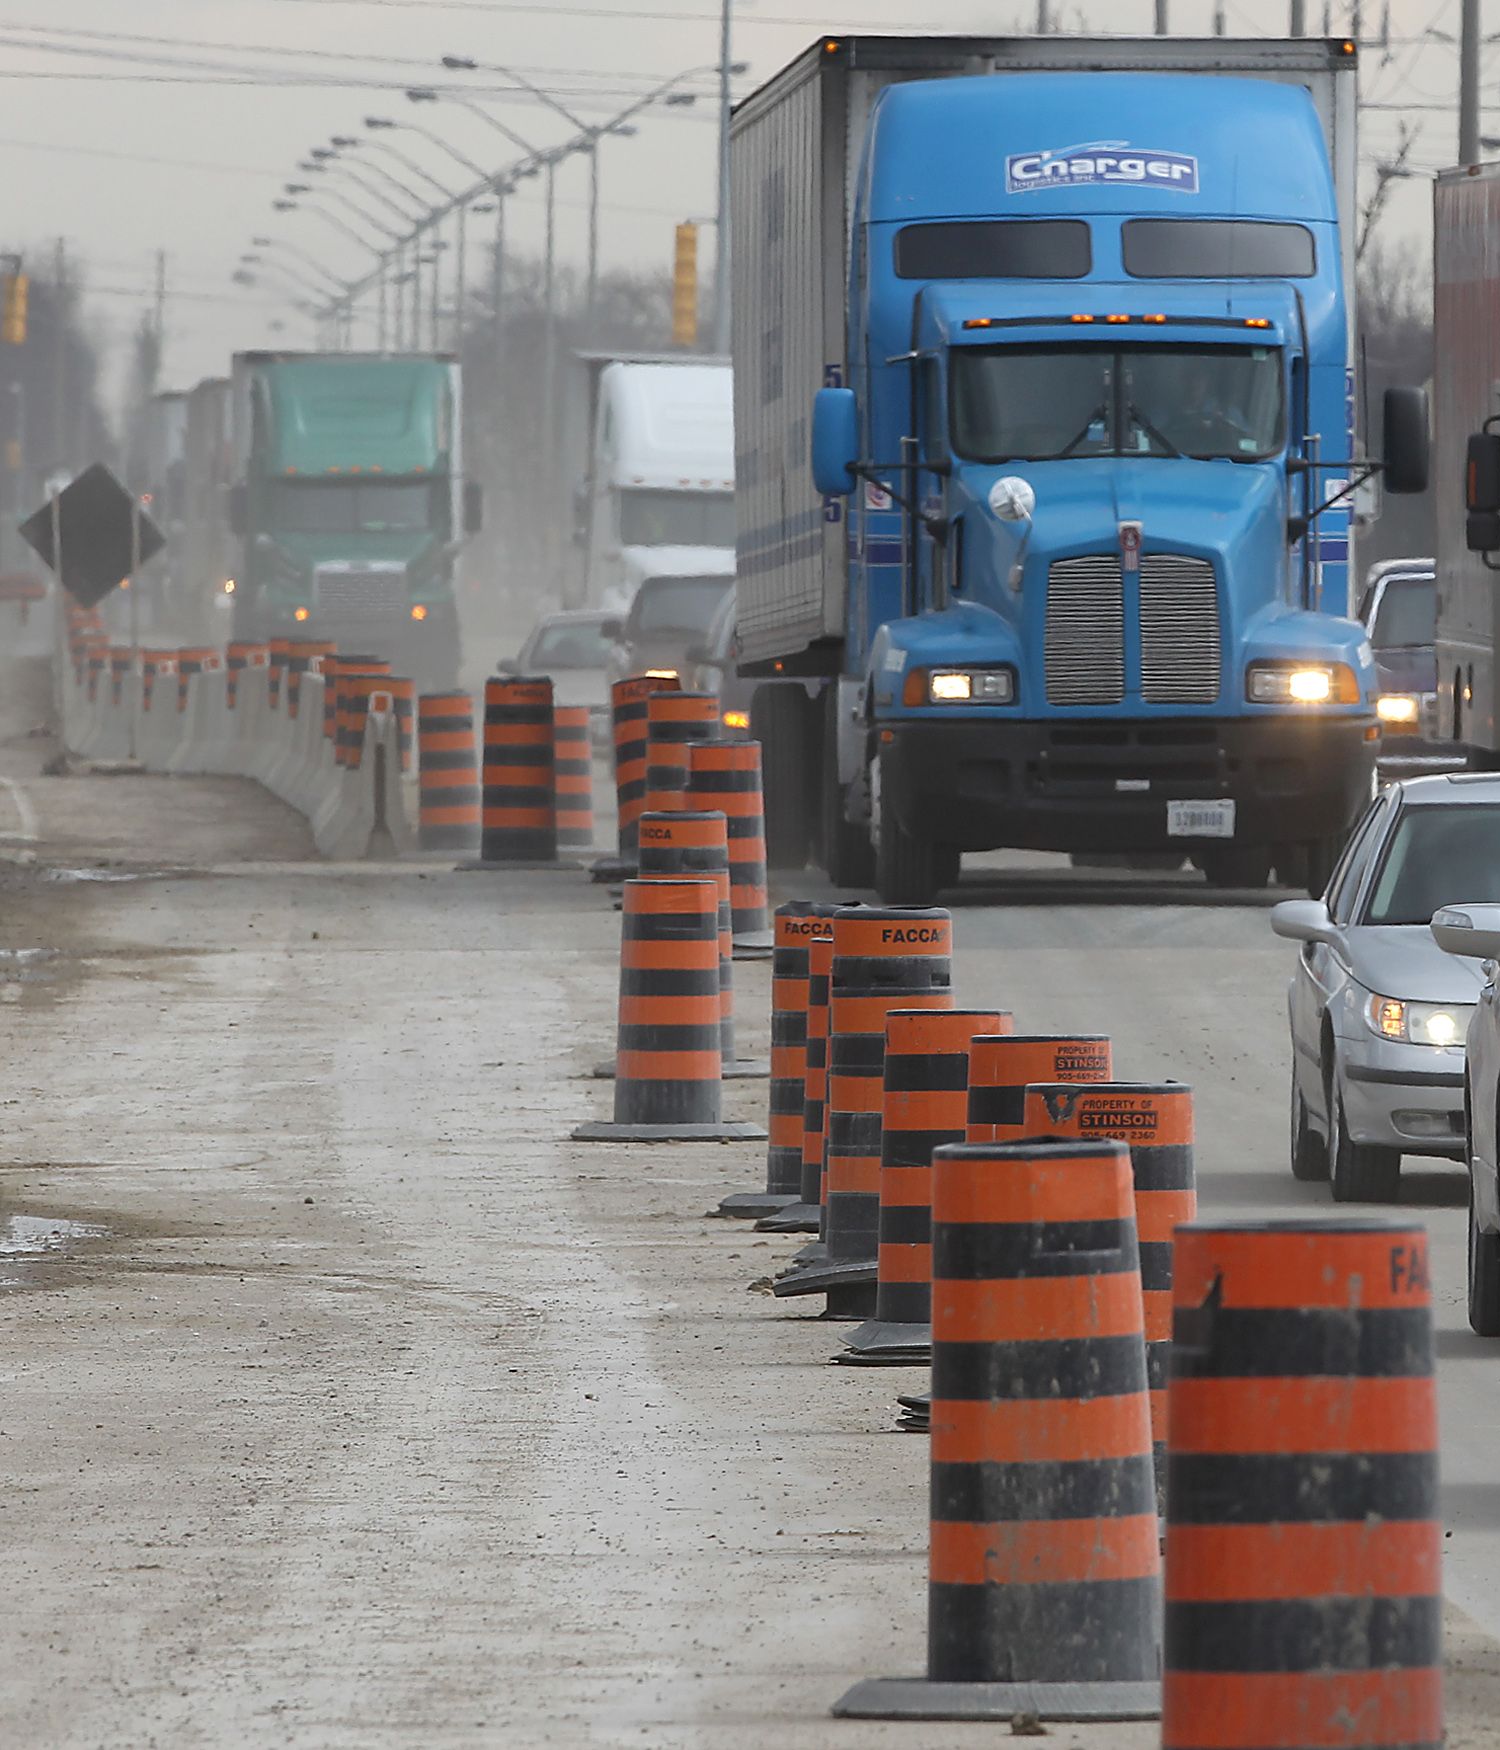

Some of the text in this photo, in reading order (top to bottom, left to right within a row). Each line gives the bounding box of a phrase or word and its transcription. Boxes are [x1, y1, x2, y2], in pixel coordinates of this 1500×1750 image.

[1011, 152, 1192, 180] Charger
[784, 922, 833, 935] FACCA
[882, 928, 942, 943] FACCA
[1082, 1100, 1152, 1109] PROPERTY OF
[1081, 1113, 1155, 1126] STINSON
